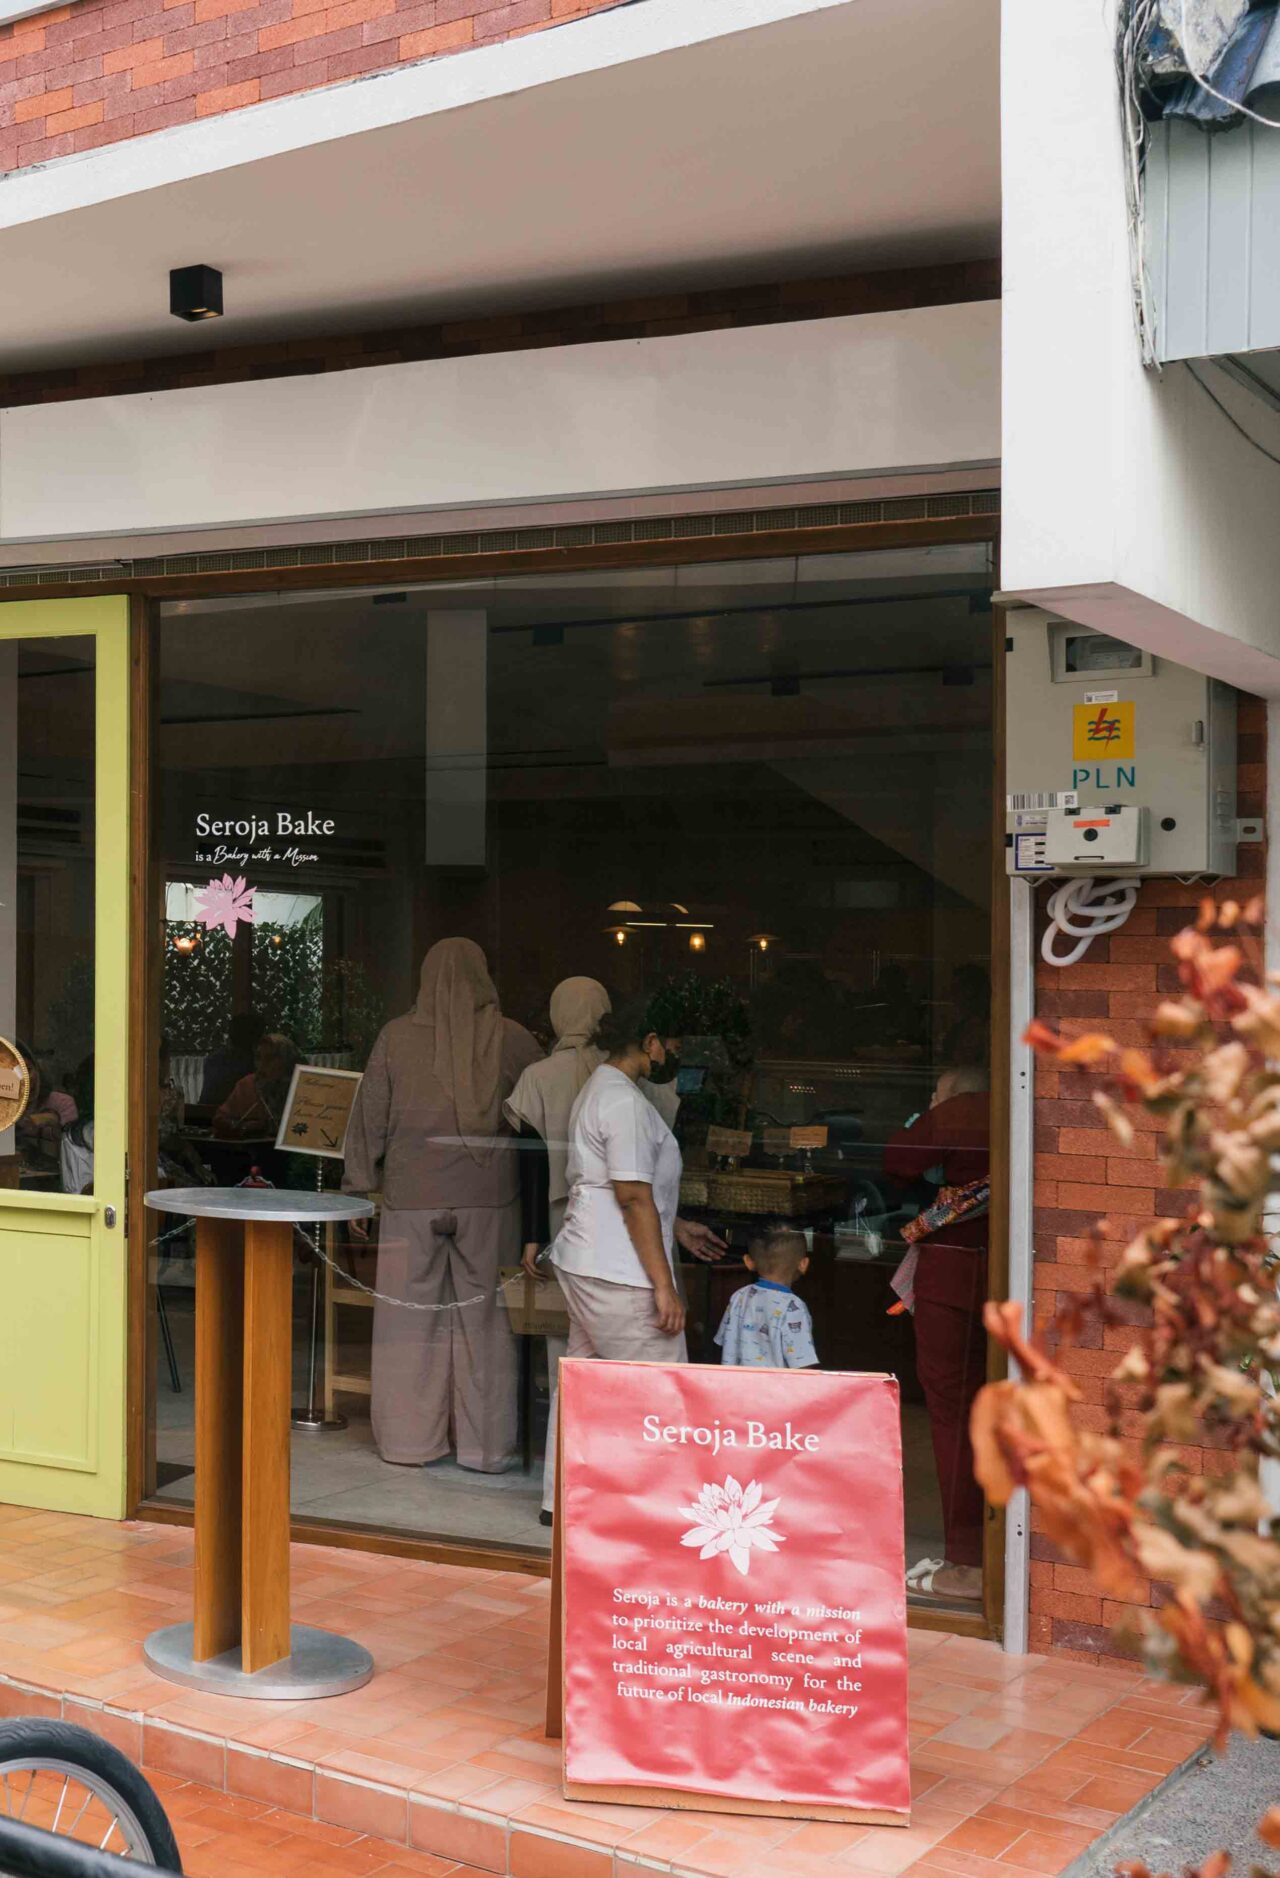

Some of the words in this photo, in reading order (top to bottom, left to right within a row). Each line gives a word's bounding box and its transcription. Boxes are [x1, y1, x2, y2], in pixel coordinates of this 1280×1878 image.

[1072, 766, 1135, 789] PLN
[196, 813, 269, 845] Seroja
[276, 811, 335, 835] Bake
[195, 851, 204, 862] is
[206, 854, 212, 862] a
[213, 846, 249, 867] Bakery
[252, 846, 272, 862] with
[273, 853, 282, 861] a
[642, 1415, 737, 1456] Seroja
[746, 1421, 820, 1452] Bake
[613, 1588, 660, 1610] Seroja
[666, 1592, 678, 1607] is
[683, 1598, 692, 1608] a
[698, 1595, 748, 1615] bakery
[754, 1601, 785, 1615] with
[791, 1605, 800, 1615] a
[806, 1605, 861, 1620] mission
[612, 1614, 629, 1626] to
[633, 1614, 703, 1632] prioritize
[708, 1618, 734, 1634] the
[738, 1620, 839, 1644] development
[844, 1629, 863, 1644] of
[612, 1634, 647, 1651] local
[665, 1641, 752, 1659] agricultural
[771, 1651, 814, 1664] scene
[833, 1653, 862, 1668] and
[612, 1659, 691, 1678] traditional
[700, 1669, 793, 1691] gastronomy
[803, 1673, 827, 1689] for
[836, 1676, 862, 1691] the
[617, 1681, 664, 1700] future
[668, 1687, 685, 1701] of
[688, 1687, 722, 1704] local
[727, 1692, 804, 1711] Indonesian
[808, 1699, 858, 1719] bakery
